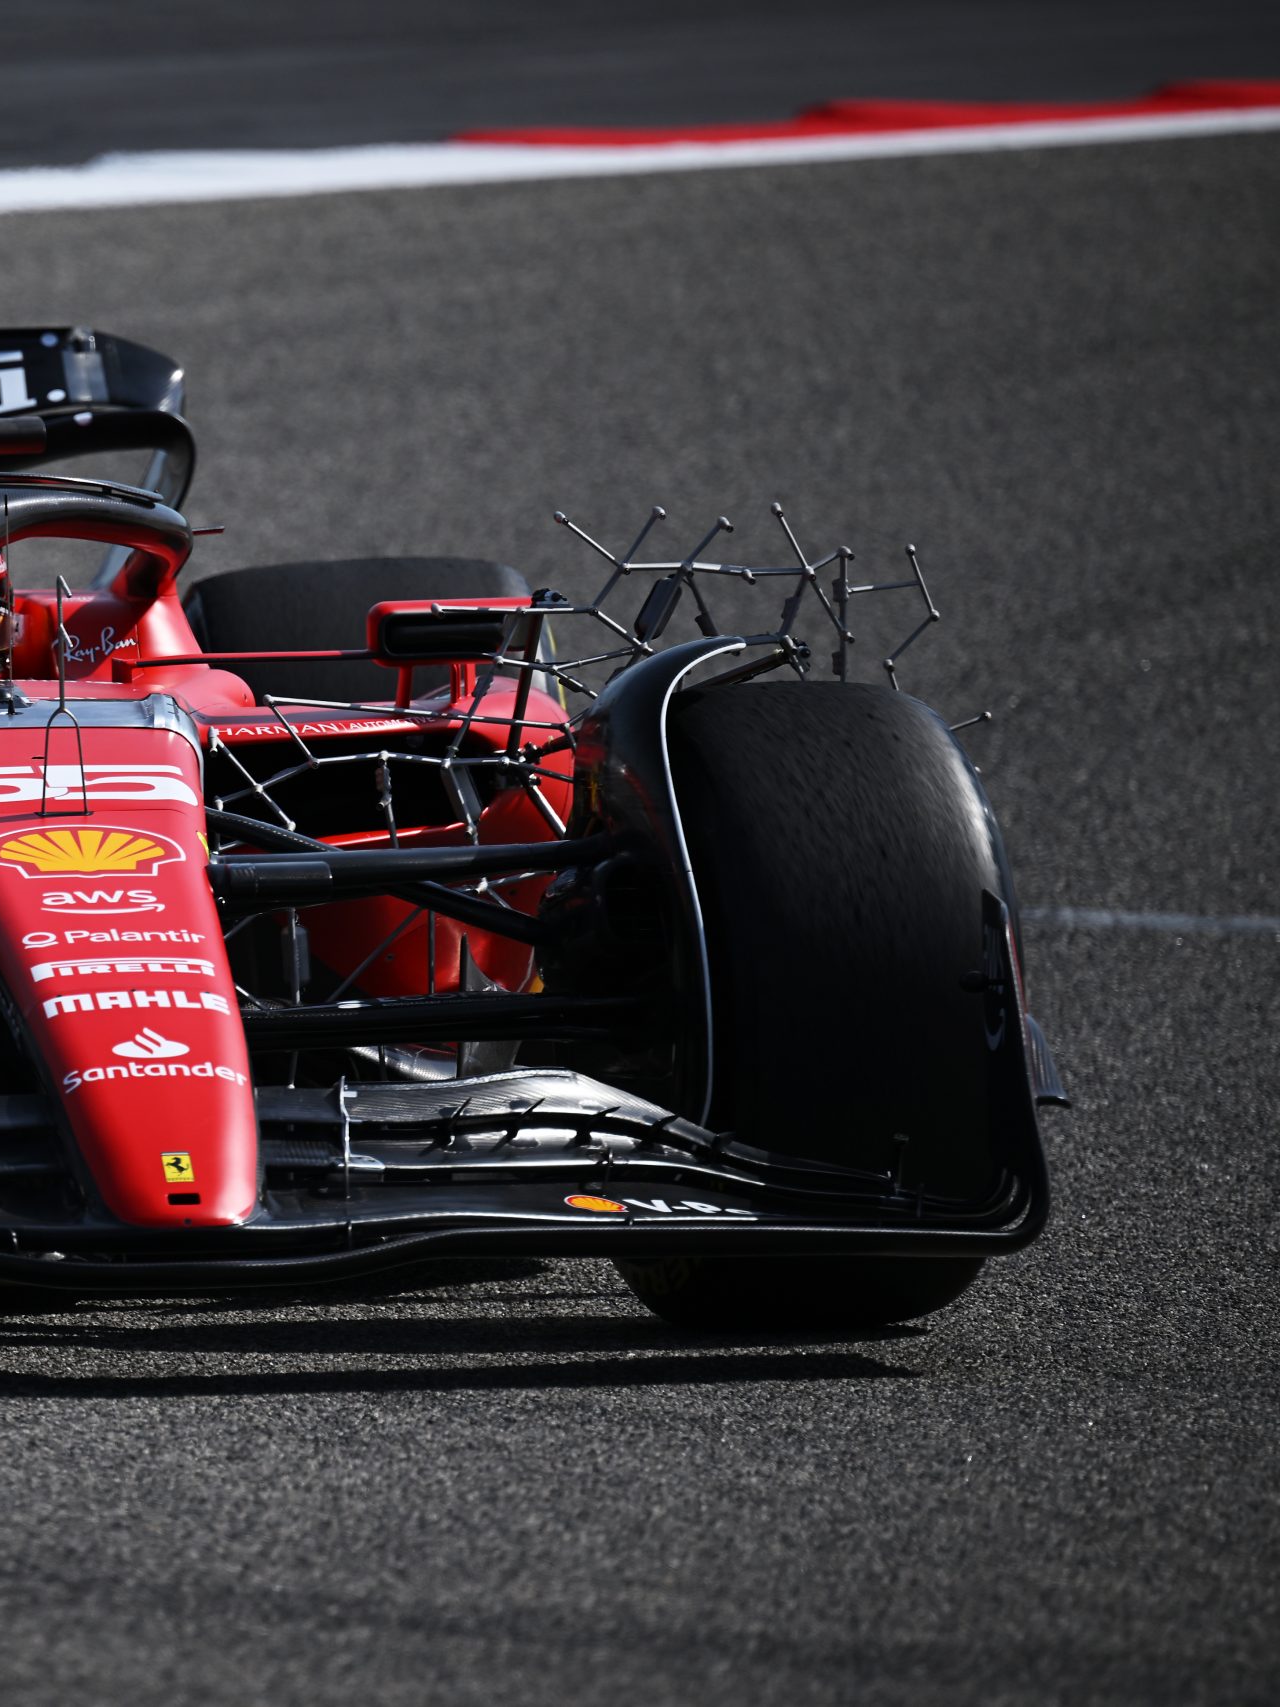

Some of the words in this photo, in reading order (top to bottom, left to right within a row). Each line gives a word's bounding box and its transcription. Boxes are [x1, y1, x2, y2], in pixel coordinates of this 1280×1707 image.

[51, 626, 136, 662] Ray-Ban
[214, 722, 340, 736] HARMAN
[41, 889, 157, 906] aws
[63, 928, 206, 944] Palantir
[30, 957, 216, 983] PIRELLI
[42, 989, 231, 1019] MAHLE
[62, 1061, 248, 1094] Santander
